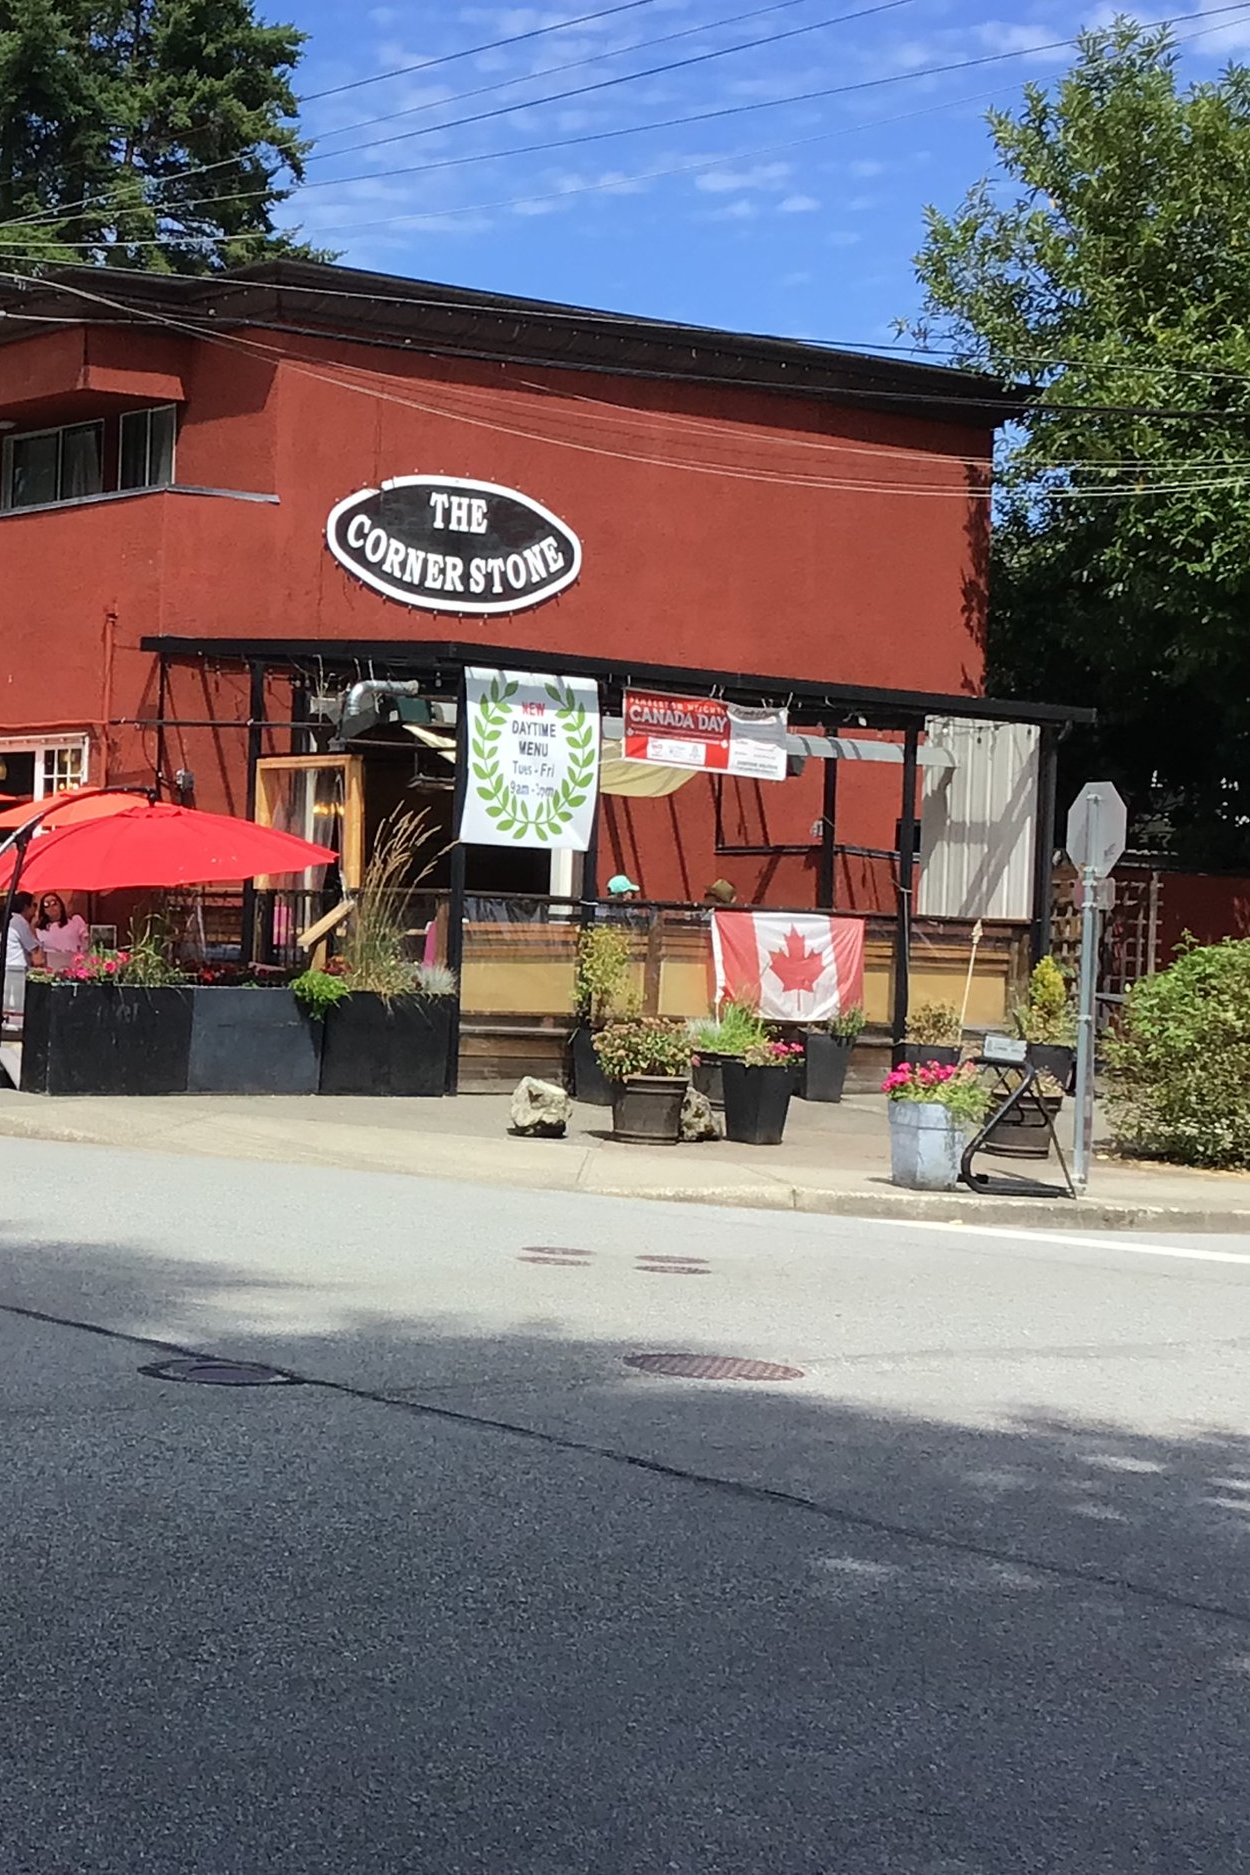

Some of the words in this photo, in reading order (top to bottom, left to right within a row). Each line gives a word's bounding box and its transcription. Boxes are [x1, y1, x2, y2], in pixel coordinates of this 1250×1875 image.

[429, 491, 488, 534] THE
[521, 701, 546, 717] NEW
[629, 704, 695, 729] CANADA
[697, 713, 728, 733] DAY
[512, 720, 556, 738] DAYTIME
[518, 741, 549, 757] MENU
[512, 760, 532, 775] Tues
[540, 763, 555, 778] Fri
